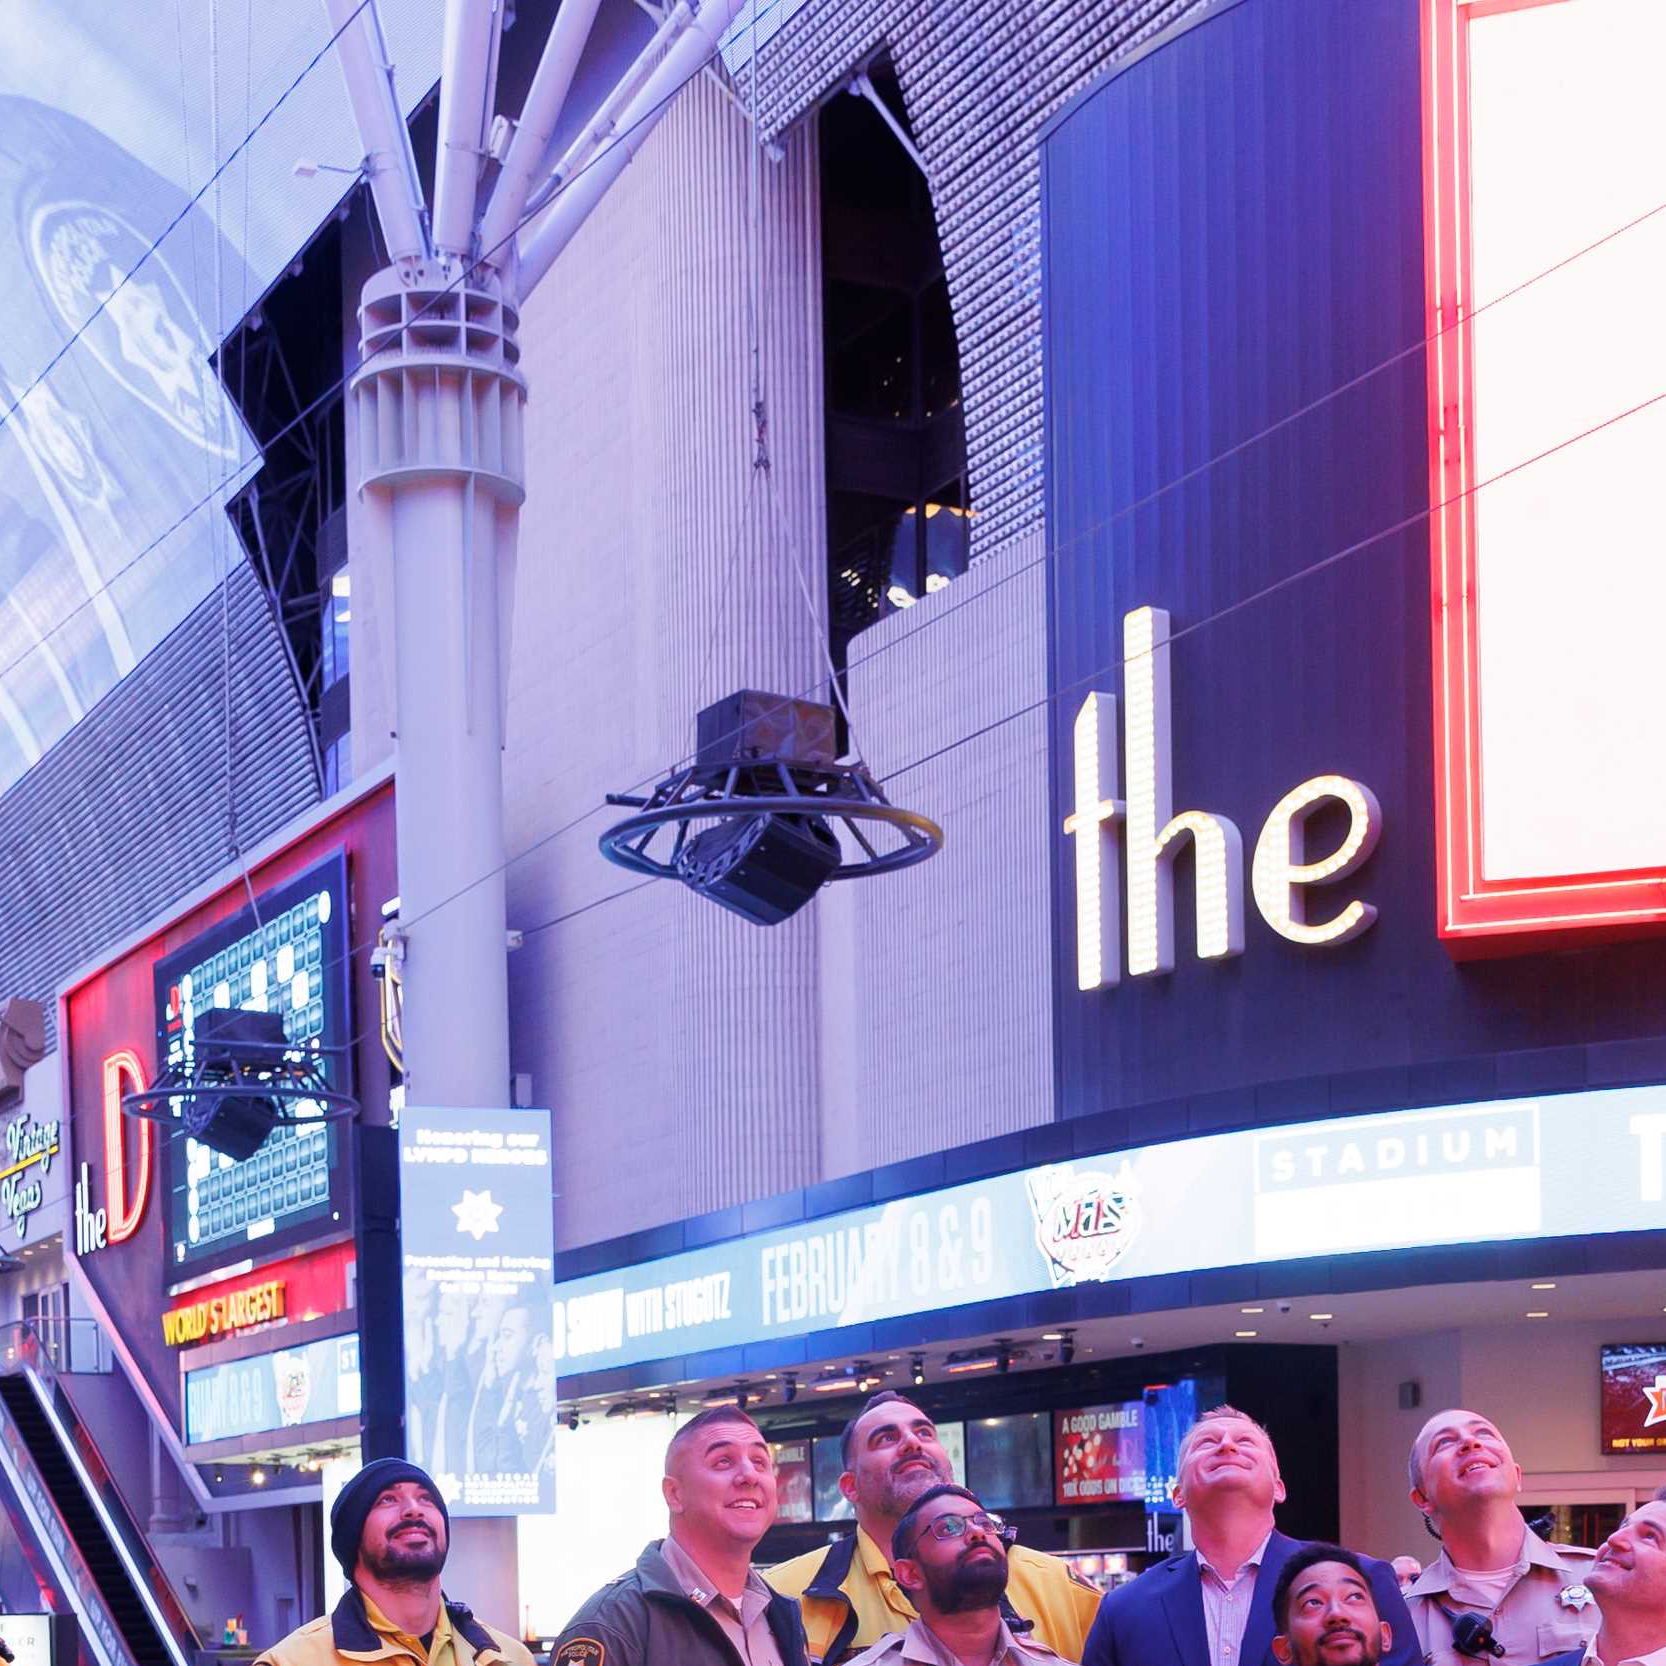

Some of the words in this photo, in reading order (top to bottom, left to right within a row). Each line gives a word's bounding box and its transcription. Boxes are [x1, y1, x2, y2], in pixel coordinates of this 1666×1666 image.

[1064, 605, 1383, 991] the
[7, 1114, 60, 1175] Vintage
[76, 1162, 107, 1256] the
[104, 1052, 153, 1244] D
[1269, 1123, 1519, 1185] STADIUM
[1, 1172, 42, 1239] Vegas
[566, 1287, 624, 1357] SHOW
[627, 1285, 663, 1338] WITH
[666, 1271, 731, 1331] STUGOTZ
[761, 1215, 904, 1327] FEBRUARY
[909, 1211, 931, 1294] 8
[937, 1208, 965, 1292] &
[969, 1198, 993, 1286] 9
[162, 1296, 218, 1346] WORLD'S
[222, 1280, 285, 1329] LARGEST
[1062, 1418, 1070, 1434] A
[1071, 1413, 1097, 1433] GOOD
[1098, 1410, 1138, 1430] GAMBLE
[1147, 1511, 1174, 1553] the
